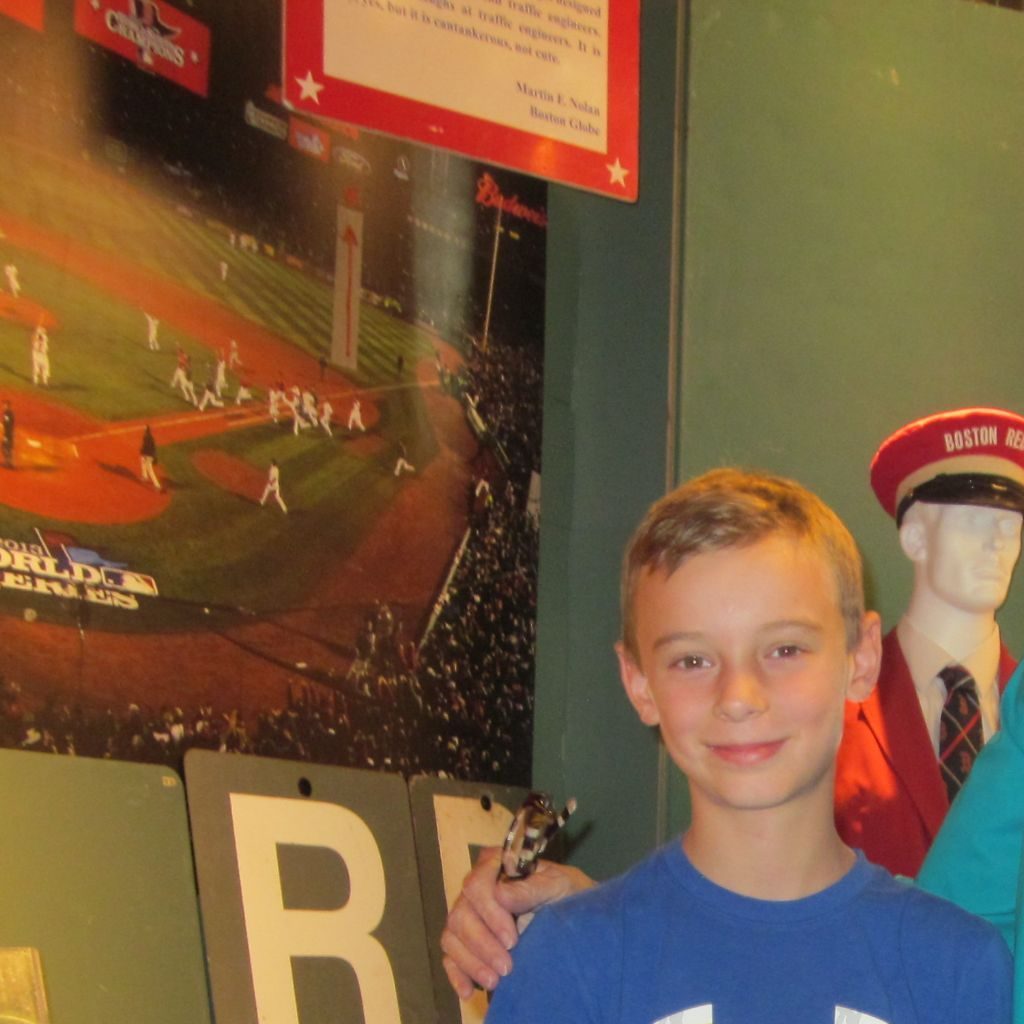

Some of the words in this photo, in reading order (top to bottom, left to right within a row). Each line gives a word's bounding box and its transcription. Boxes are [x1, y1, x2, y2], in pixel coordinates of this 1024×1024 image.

[515, 80, 554, 103] Martin
[570, 97, 600, 116] Nolan
[530, 104, 566, 127] Boston
[569, 118, 600, 137] Globe
[944, 426, 998, 453] BOSTON
